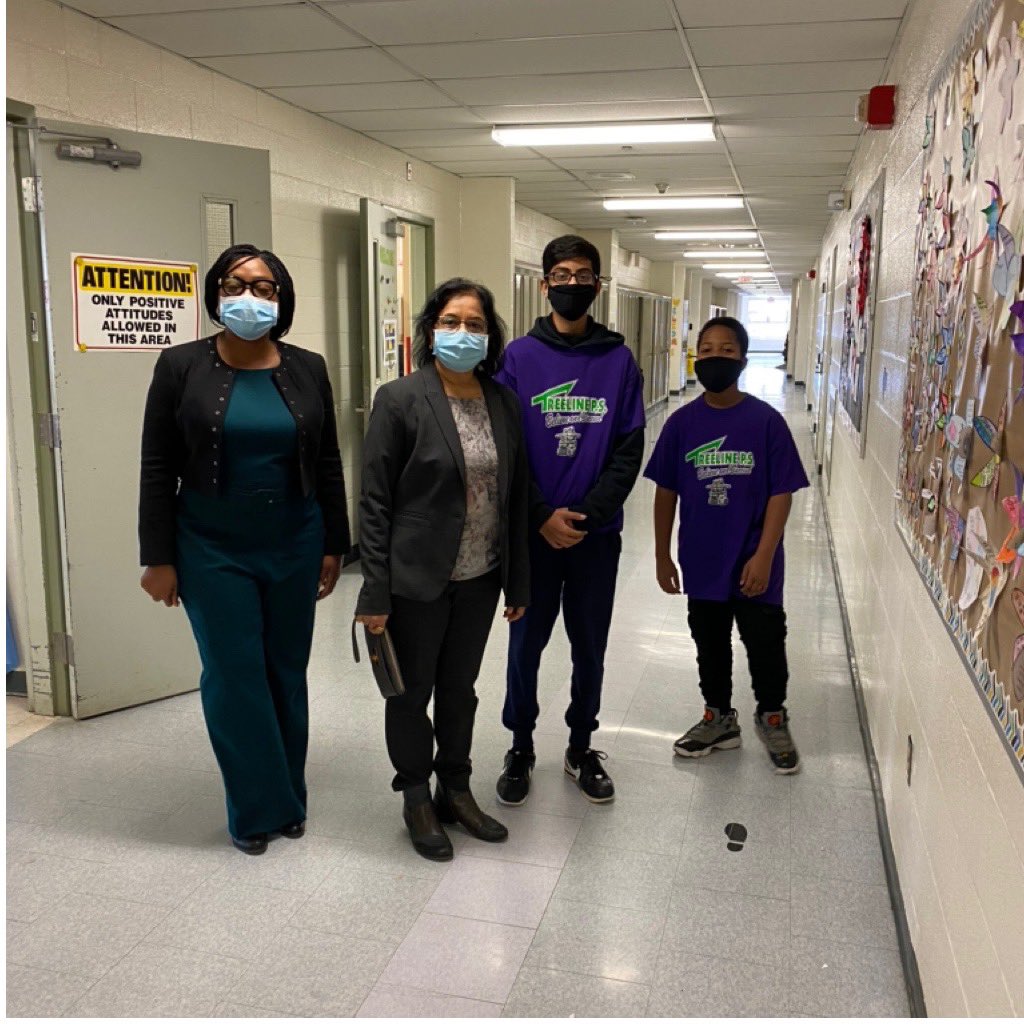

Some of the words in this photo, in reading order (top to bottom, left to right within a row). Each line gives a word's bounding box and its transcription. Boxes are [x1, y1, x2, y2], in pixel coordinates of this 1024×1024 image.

[82, 265, 193, 293] ATTENTION!
[91, 294, 124, 307] ONLY
[129, 296, 185, 310] POSITIVE
[105, 308, 174, 321] ATTITUDES
[101, 320, 161, 333] ALLOWED
[164, 322, 177, 334] IN
[108, 333, 137, 345] THIS
[140, 335, 172, 346] AREA
[531, 378, 589, 413] TREELINE
[685, 435, 737, 467] TREELINE
